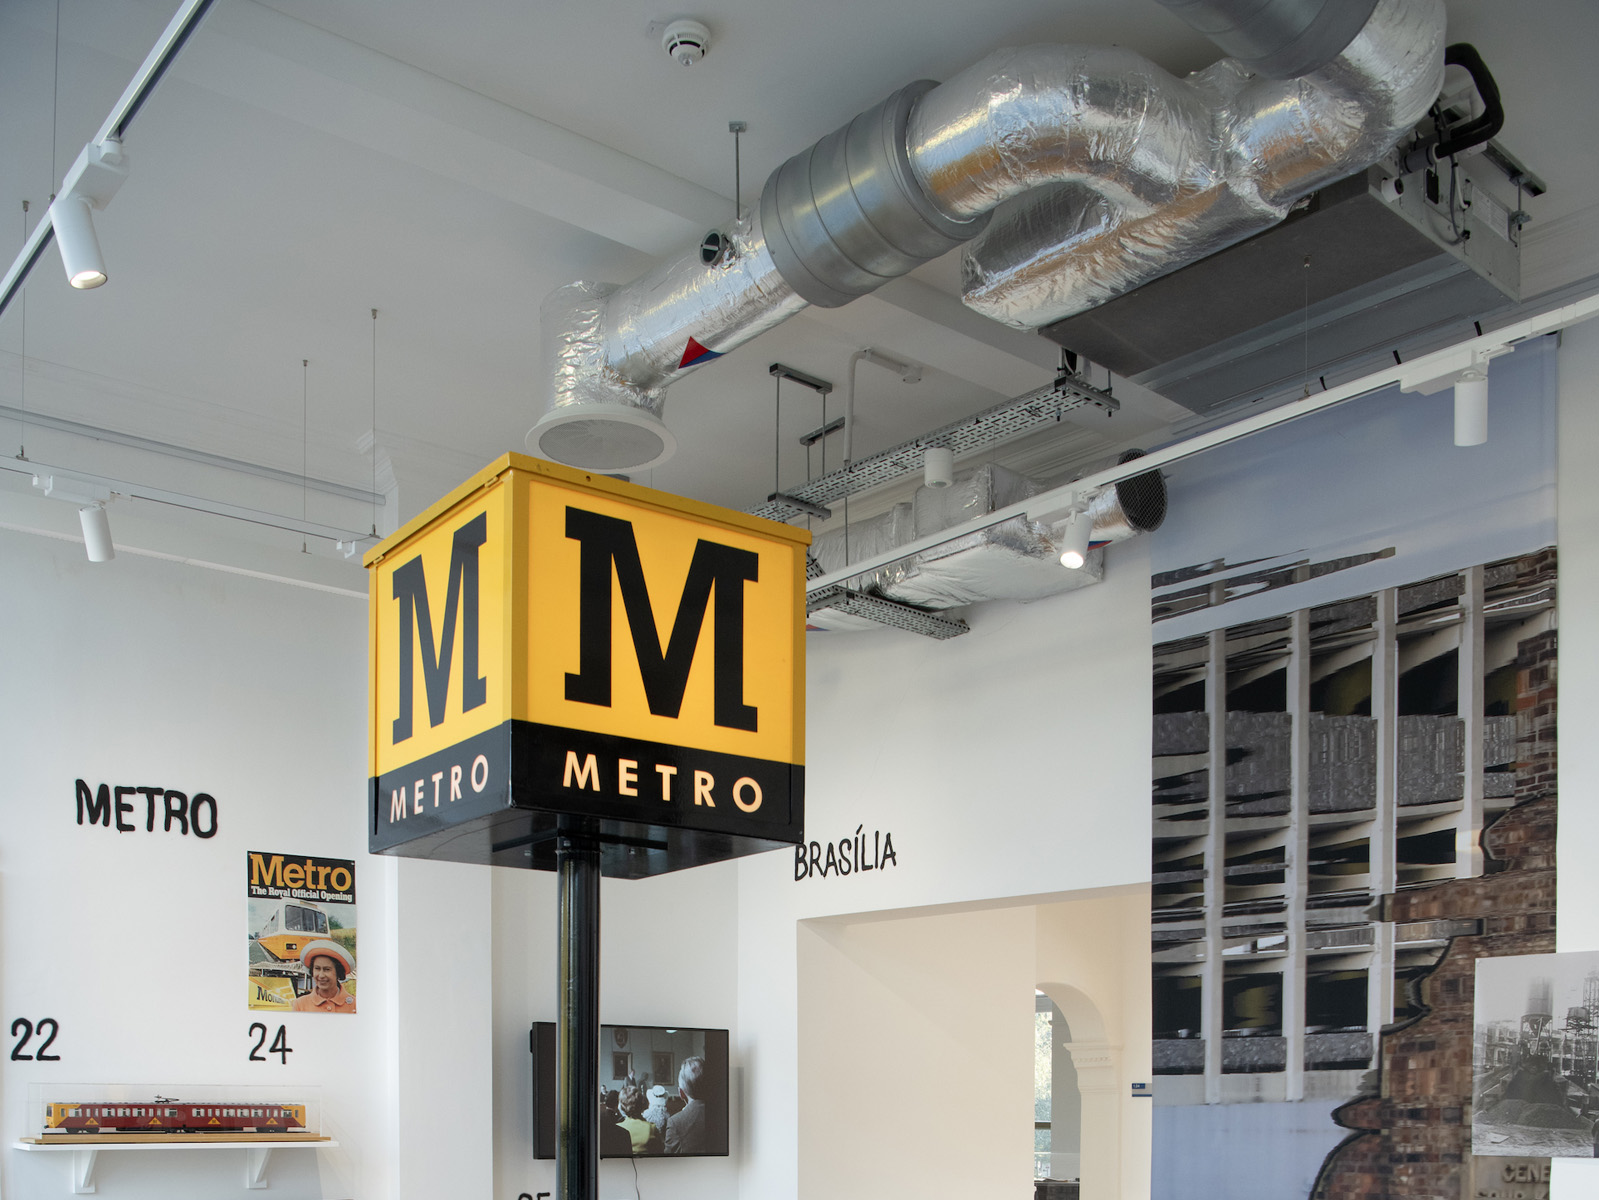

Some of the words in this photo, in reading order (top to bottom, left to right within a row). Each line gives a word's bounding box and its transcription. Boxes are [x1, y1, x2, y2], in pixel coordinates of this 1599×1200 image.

[392, 510, 487, 745] M
[564, 505, 759, 733] M
[75, 778, 218, 839] METRO
[389, 754, 489, 823] METRO
[562, 750, 763, 813] METRO
[250, 854, 352, 891] Metro
[794, 823, 897, 882] BRASÍLIA
[250, 886, 267, 895] The
[268, 886, 291, 898] Royal
[291, 889, 319, 899] Official
[321, 890, 352, 902] Opening
[10, 1017, 61, 1061] 22
[248, 1021, 293, 1065] 24
